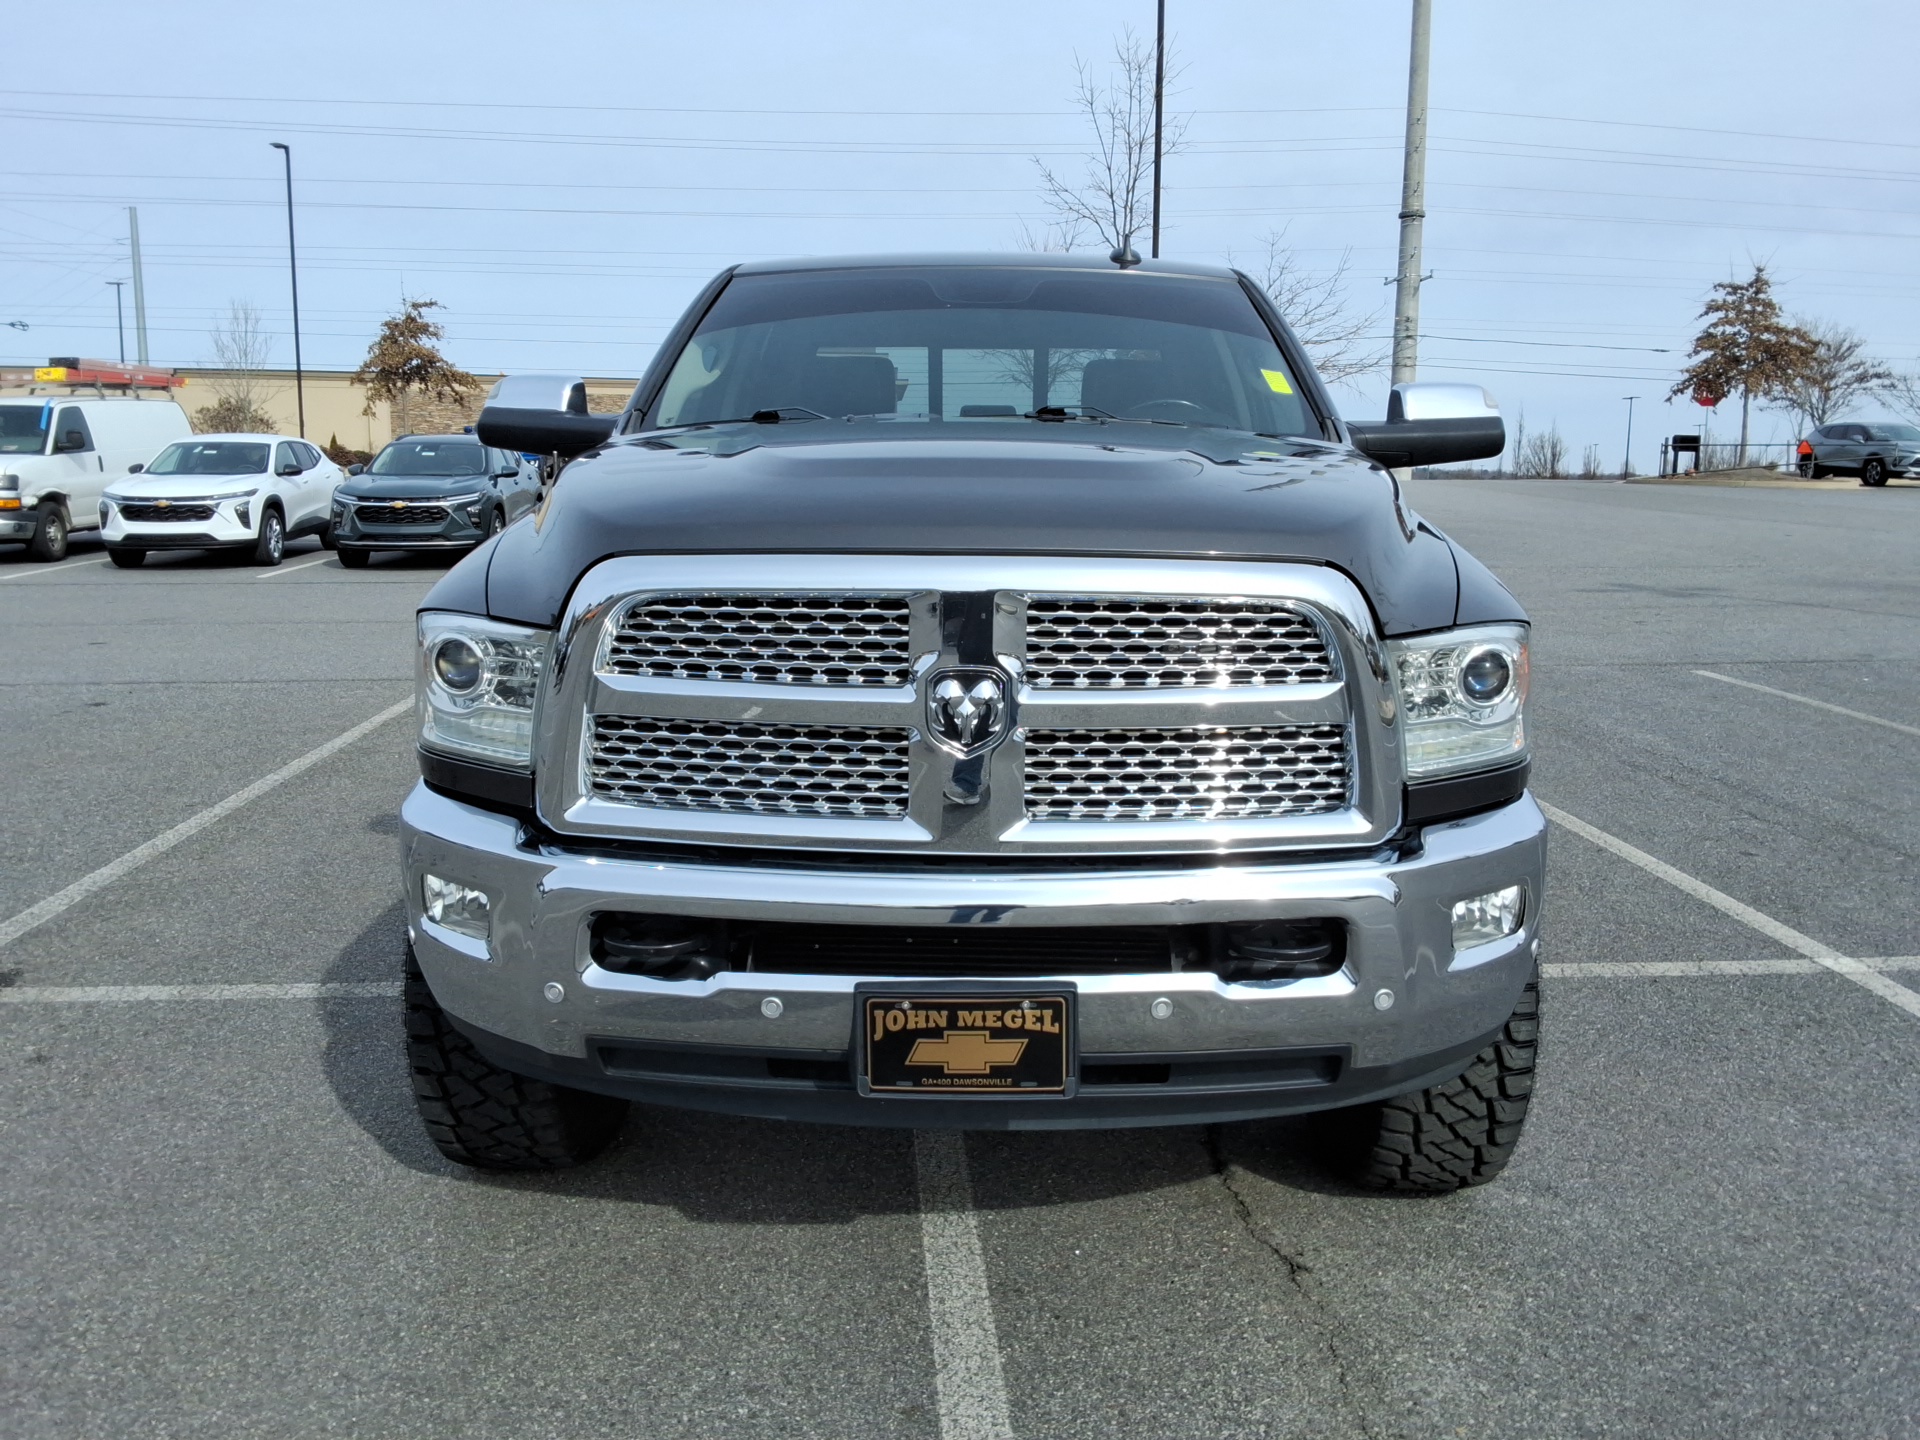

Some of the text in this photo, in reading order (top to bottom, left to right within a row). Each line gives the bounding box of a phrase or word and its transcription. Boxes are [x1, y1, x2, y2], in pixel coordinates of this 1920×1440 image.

[874, 1009, 1059, 1041] JOHN MEGEL
[953, 1078, 1012, 1086] DAWSONVILLE
